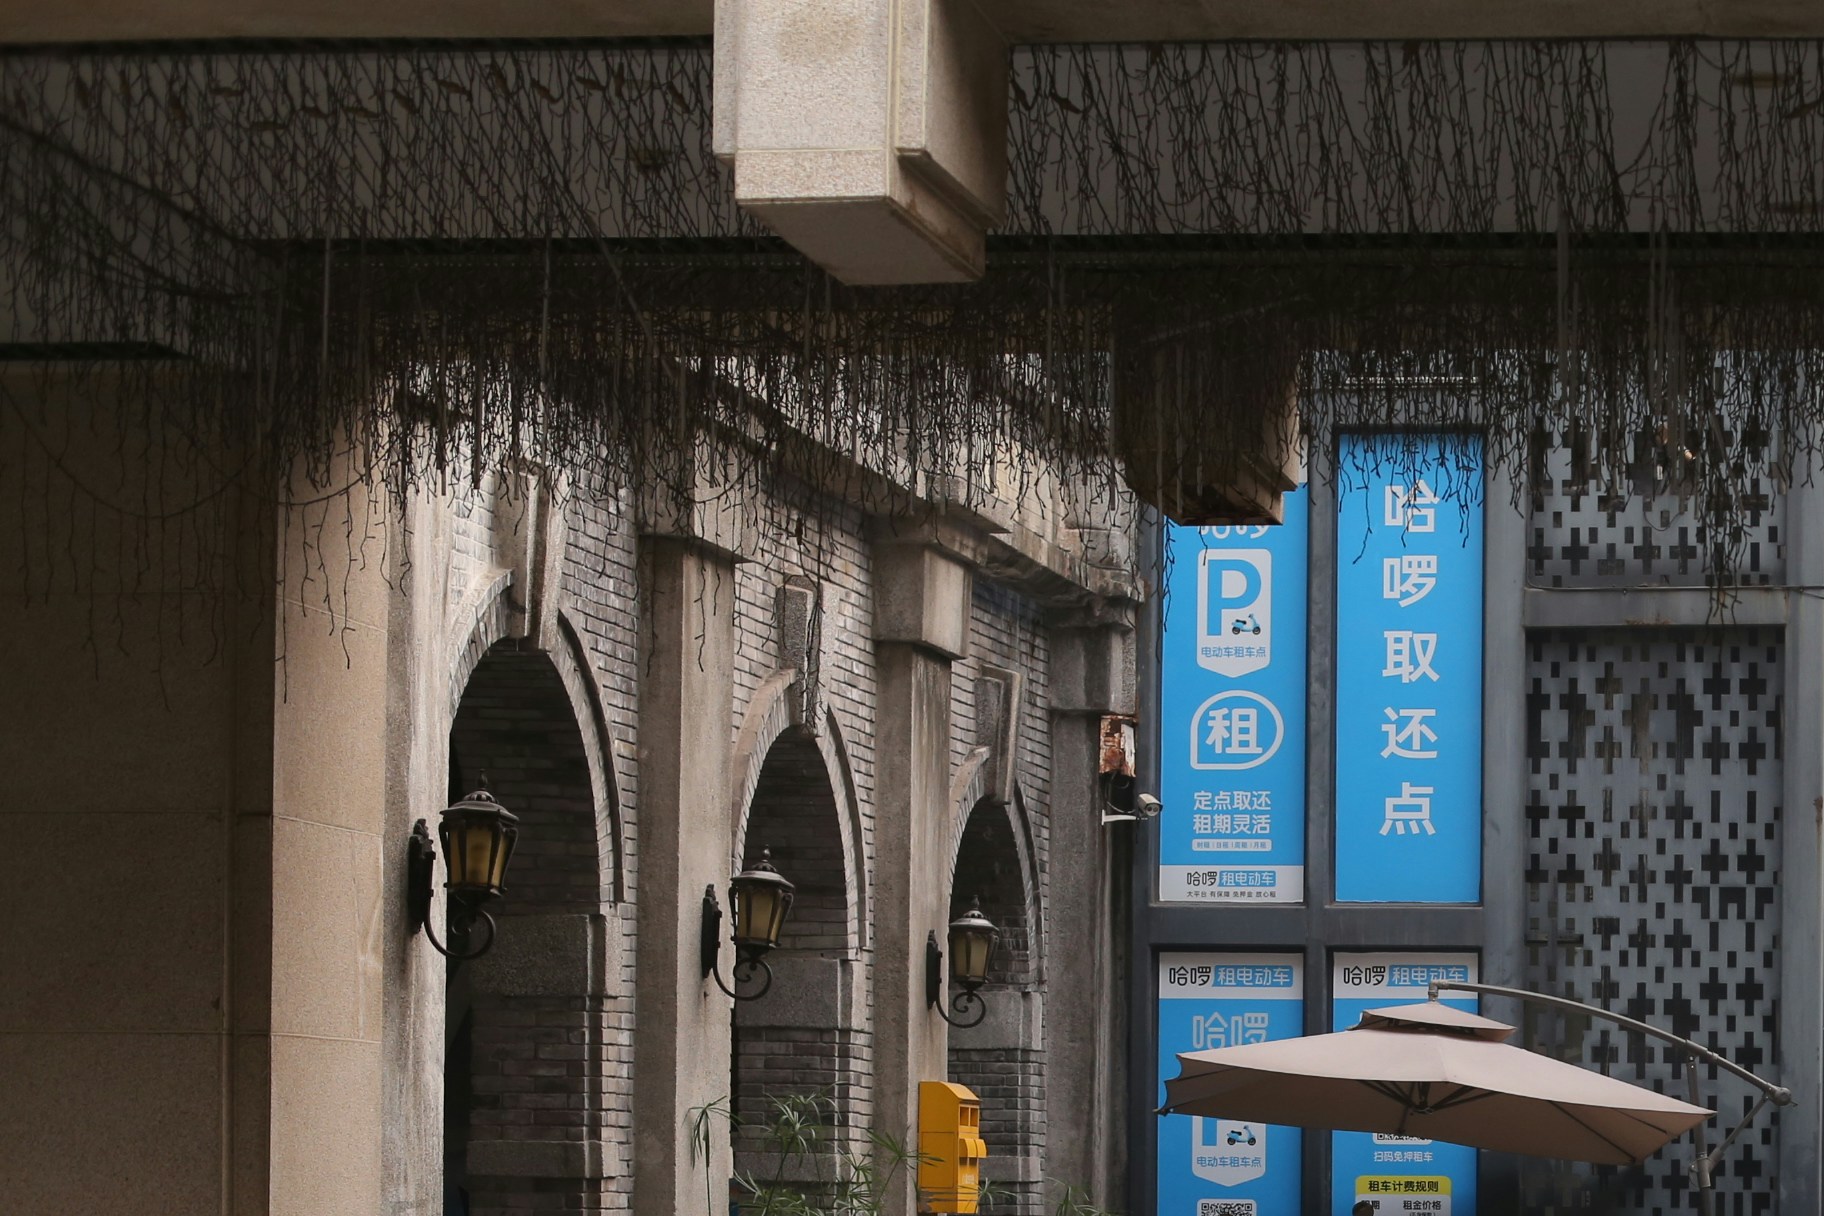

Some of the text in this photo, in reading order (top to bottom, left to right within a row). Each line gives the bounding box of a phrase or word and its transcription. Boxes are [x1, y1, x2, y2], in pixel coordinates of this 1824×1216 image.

[1201, 646, 1266, 658] 电动车租车点
[1379, 480, 1439, 836] 哈啰取还点
[1206, 707, 1263, 754] 租
[1193, 791, 1271, 810] 定点取还
[1193, 814, 1271, 834] 租期灵活
[1192, 1011, 1269, 1050] 哈啰
[1196, 1156, 1262, 1168] 电动车租车点
[1374, 1151, 1433, 1162] 扫码免押租车
[1368, 1180, 1439, 1192] 租车计费规则
[1403, 1200, 1442, 1211] 租金价格
